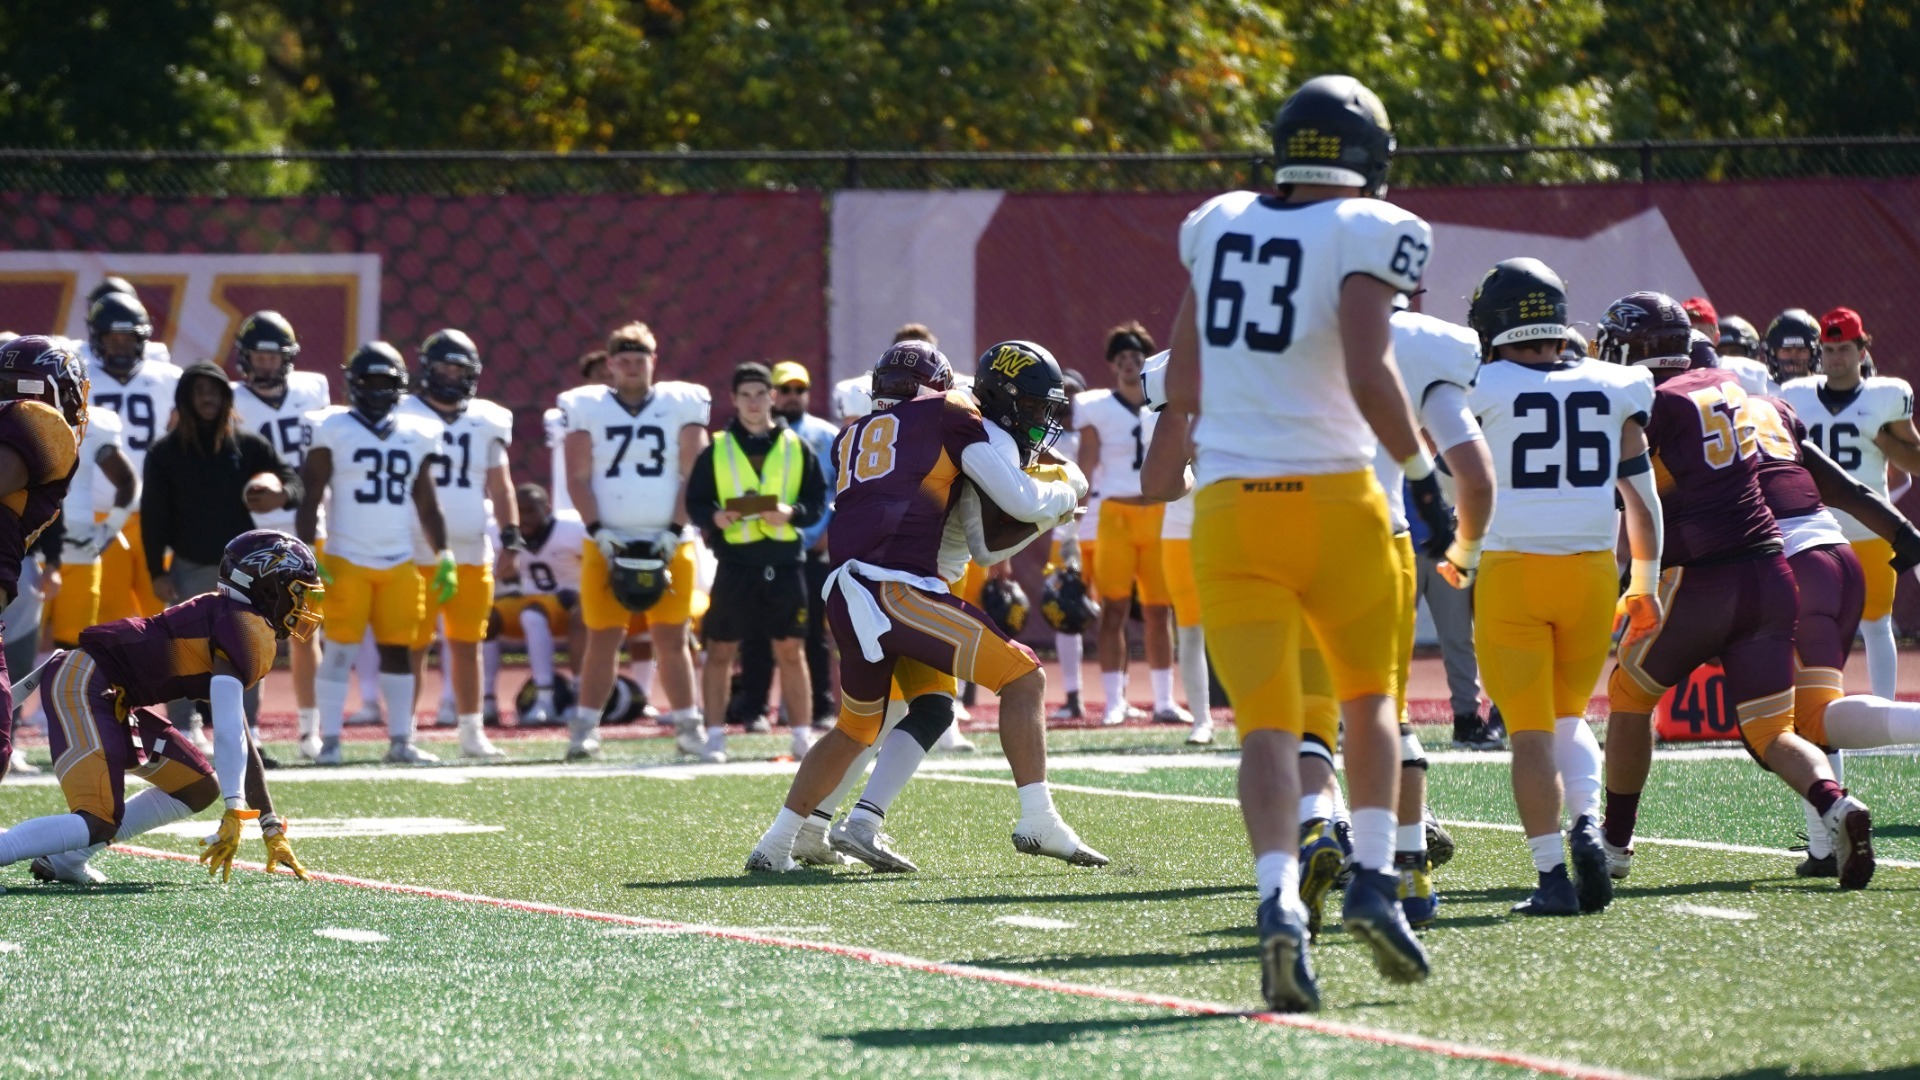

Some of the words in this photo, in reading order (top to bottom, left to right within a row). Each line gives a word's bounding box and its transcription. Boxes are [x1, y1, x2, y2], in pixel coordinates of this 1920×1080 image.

[1389, 233, 1429, 282] 63
[1204, 231, 1303, 354] 63
[890, 350, 919, 368] 18
[1506, 325, 1564, 341] COLONELS
[604, 424, 666, 478] 73
[836, 412, 900, 496] 18
[1511, 391, 1611, 489] 26
[1809, 422, 1862, 471] 16
[353, 448, 412, 505] 38
[1242, 481, 1304, 493] WILKES
[1670, 674, 1736, 734] 40
